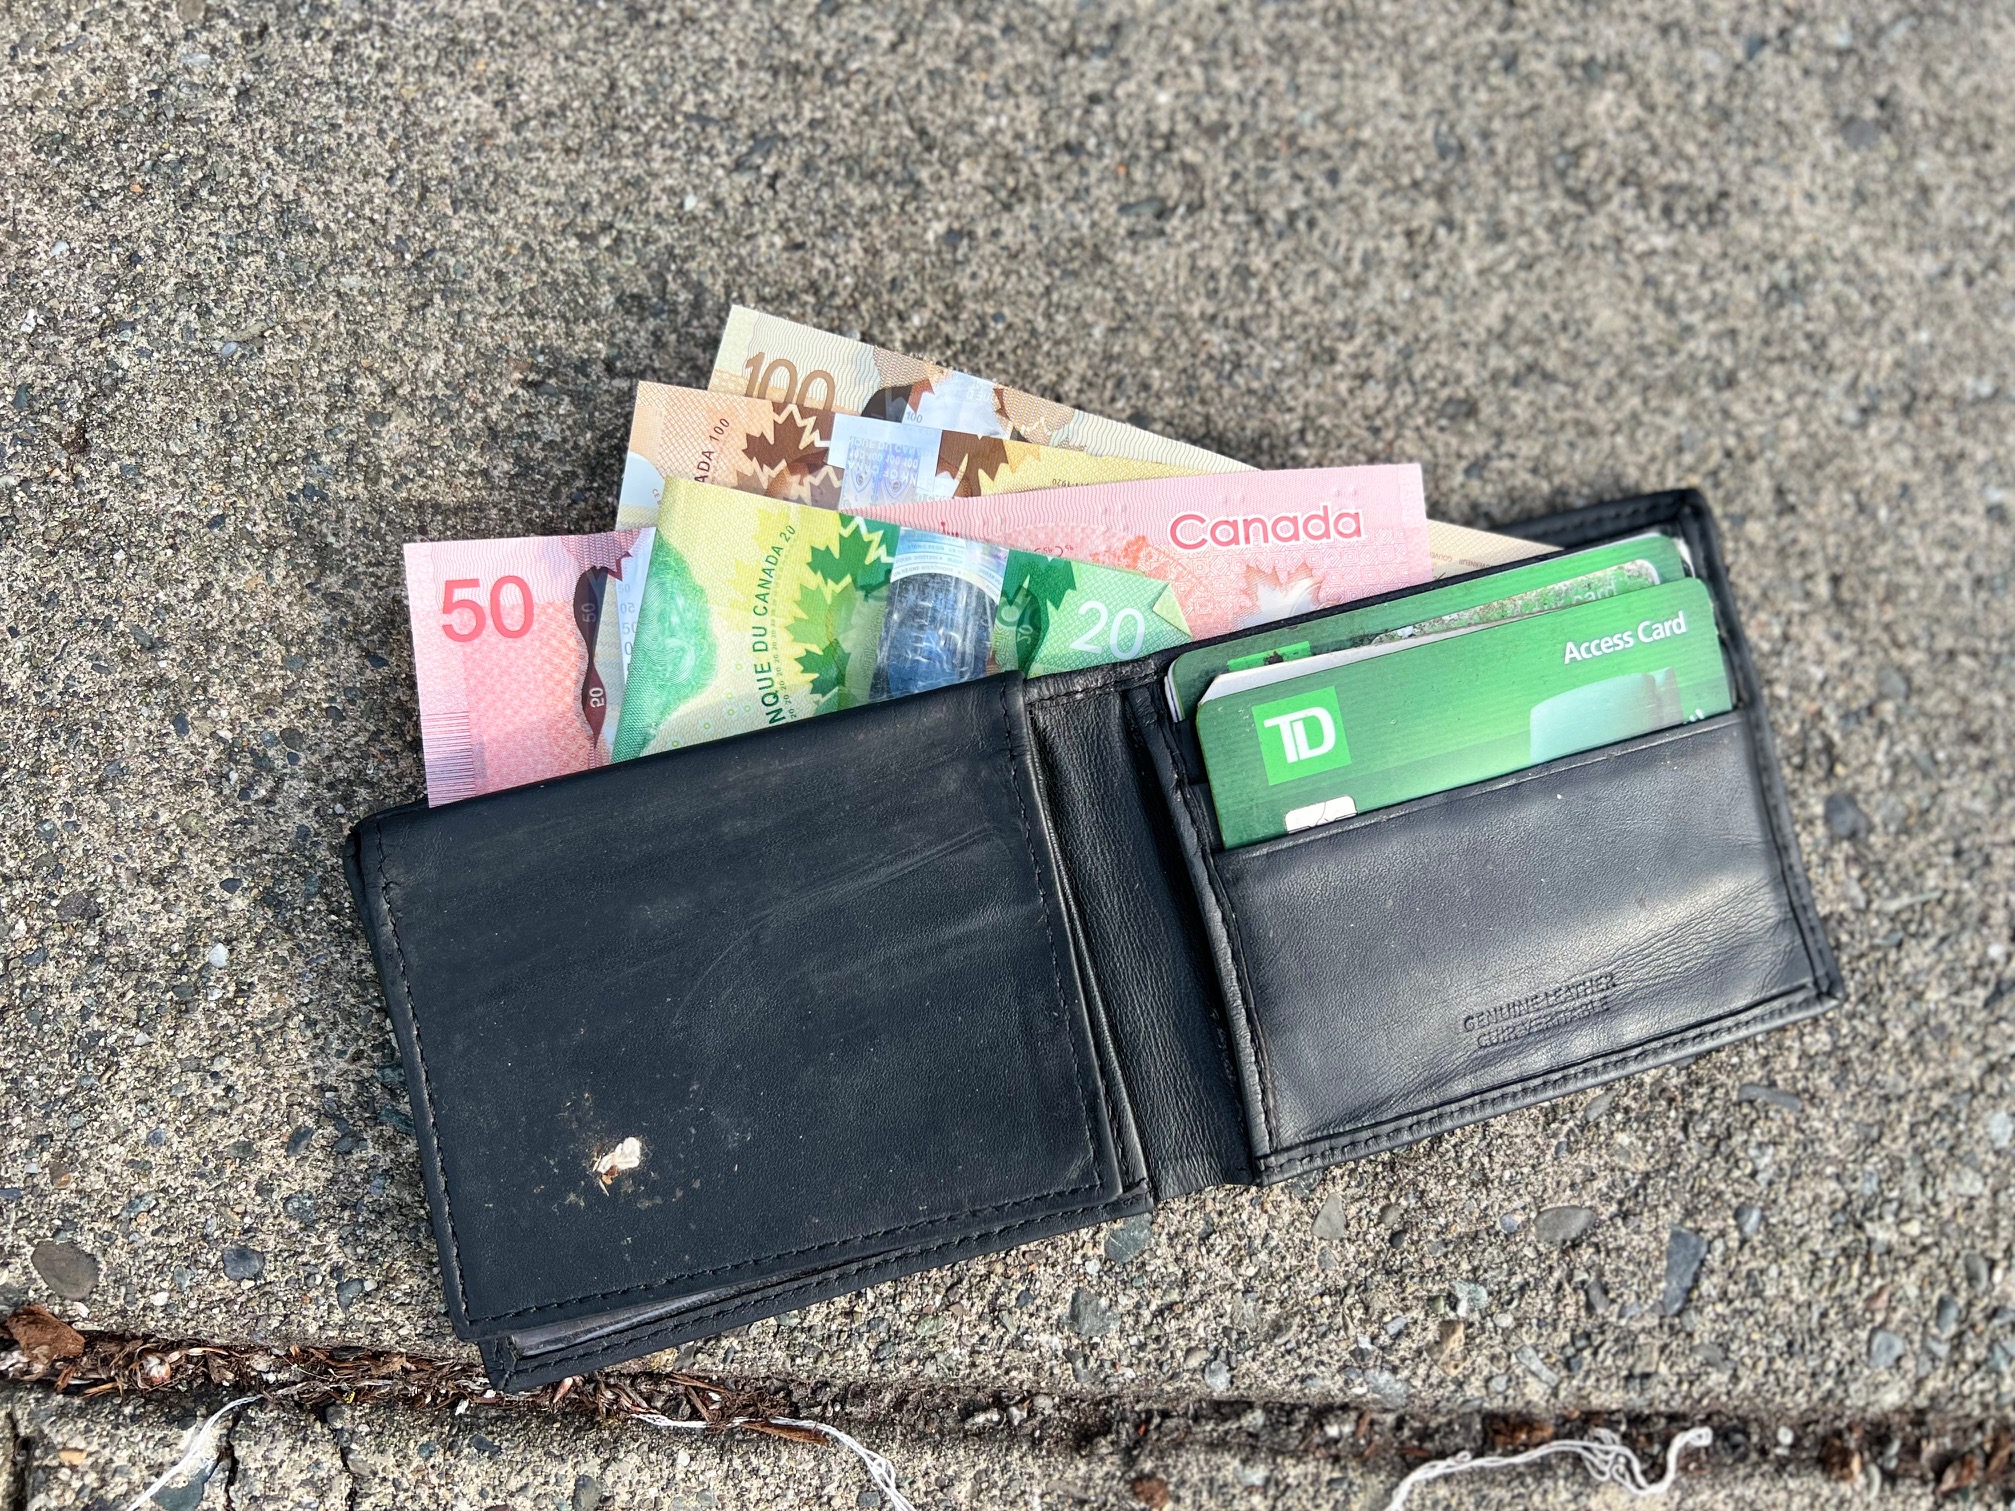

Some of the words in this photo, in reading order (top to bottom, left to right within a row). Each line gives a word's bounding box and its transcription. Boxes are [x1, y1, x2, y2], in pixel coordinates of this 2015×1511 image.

[745, 352, 835, 411] 100
[906, 412, 923, 424] 100
[694, 451, 715, 482] ADA
[709, 418, 730, 442] 100
[779, 525, 796, 544] 20
[1170, 505, 1361, 550] Canada
[753, 544, 783, 617] CANADA
[442, 575, 535, 644] 50
[1069, 601, 1145, 660] 20
[1564, 631, 1635, 665] Access
[1637, 610, 1687, 643] Card
[752, 626, 769, 653] DU
[1263, 707, 1337, 763] TD
[1463, 995, 1539, 1033] GENUINE
[1544, 972, 1617, 1005] LEATHER
